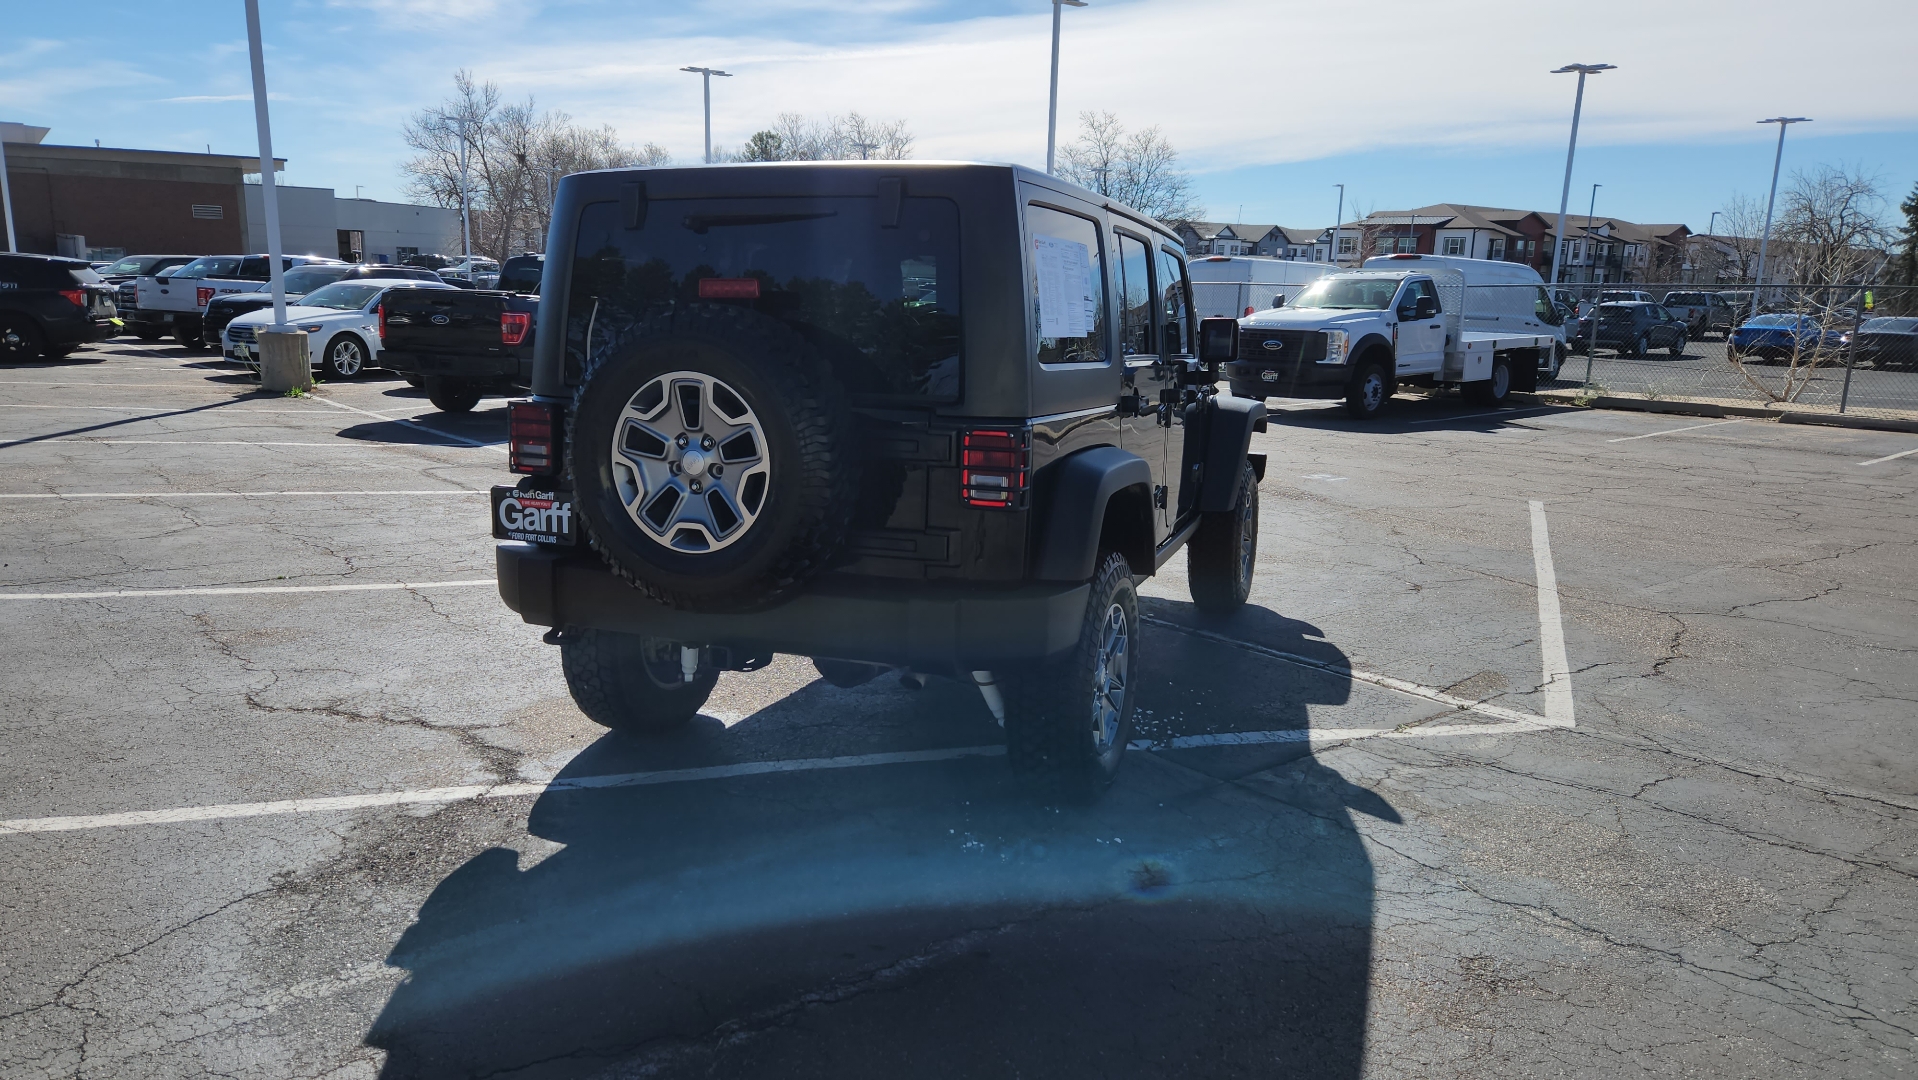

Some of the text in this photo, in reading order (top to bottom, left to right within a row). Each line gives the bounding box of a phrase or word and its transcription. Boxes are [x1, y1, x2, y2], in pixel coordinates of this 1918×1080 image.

[535, 490, 554, 500] Garff
[499, 498, 571, 534] Garff
[511, 532, 557, 544] FORD FORT COLLINS
